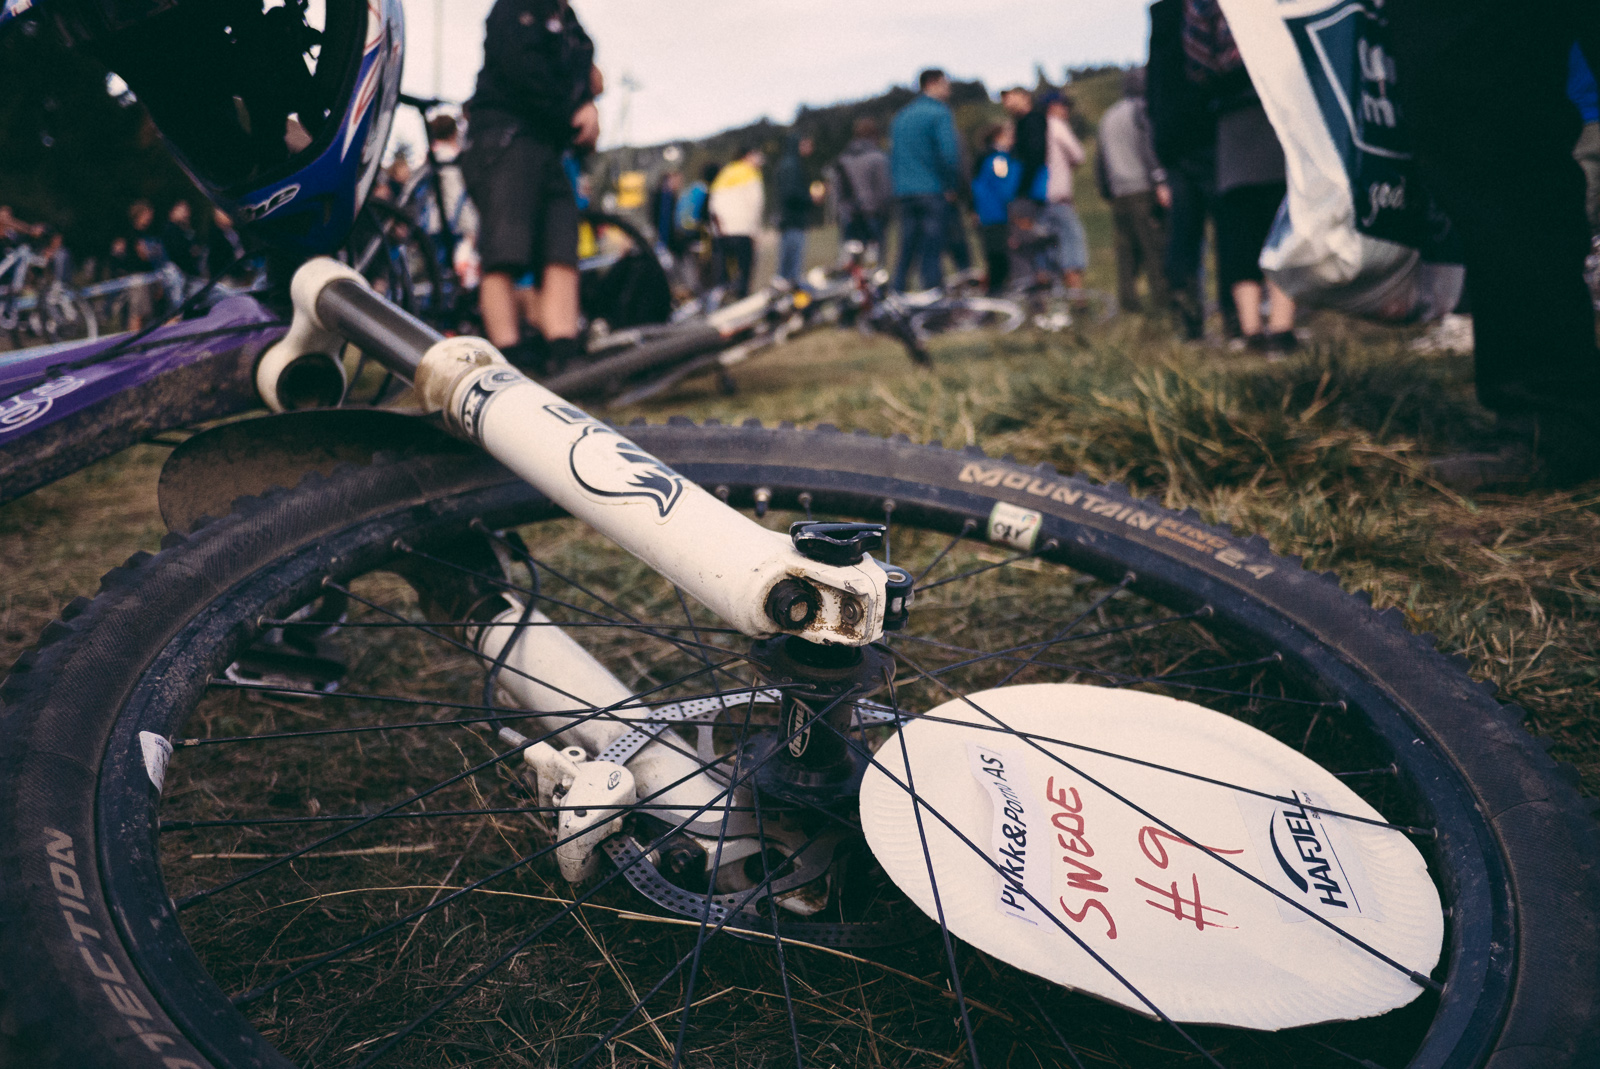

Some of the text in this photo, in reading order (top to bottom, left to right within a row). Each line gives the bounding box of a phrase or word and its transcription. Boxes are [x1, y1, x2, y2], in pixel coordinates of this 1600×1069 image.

[958, 462, 1160, 531] MOUNTAIN
[1046, 776, 1118, 939] SWEDE
[1276, 789, 1348, 909] HAFJELL
